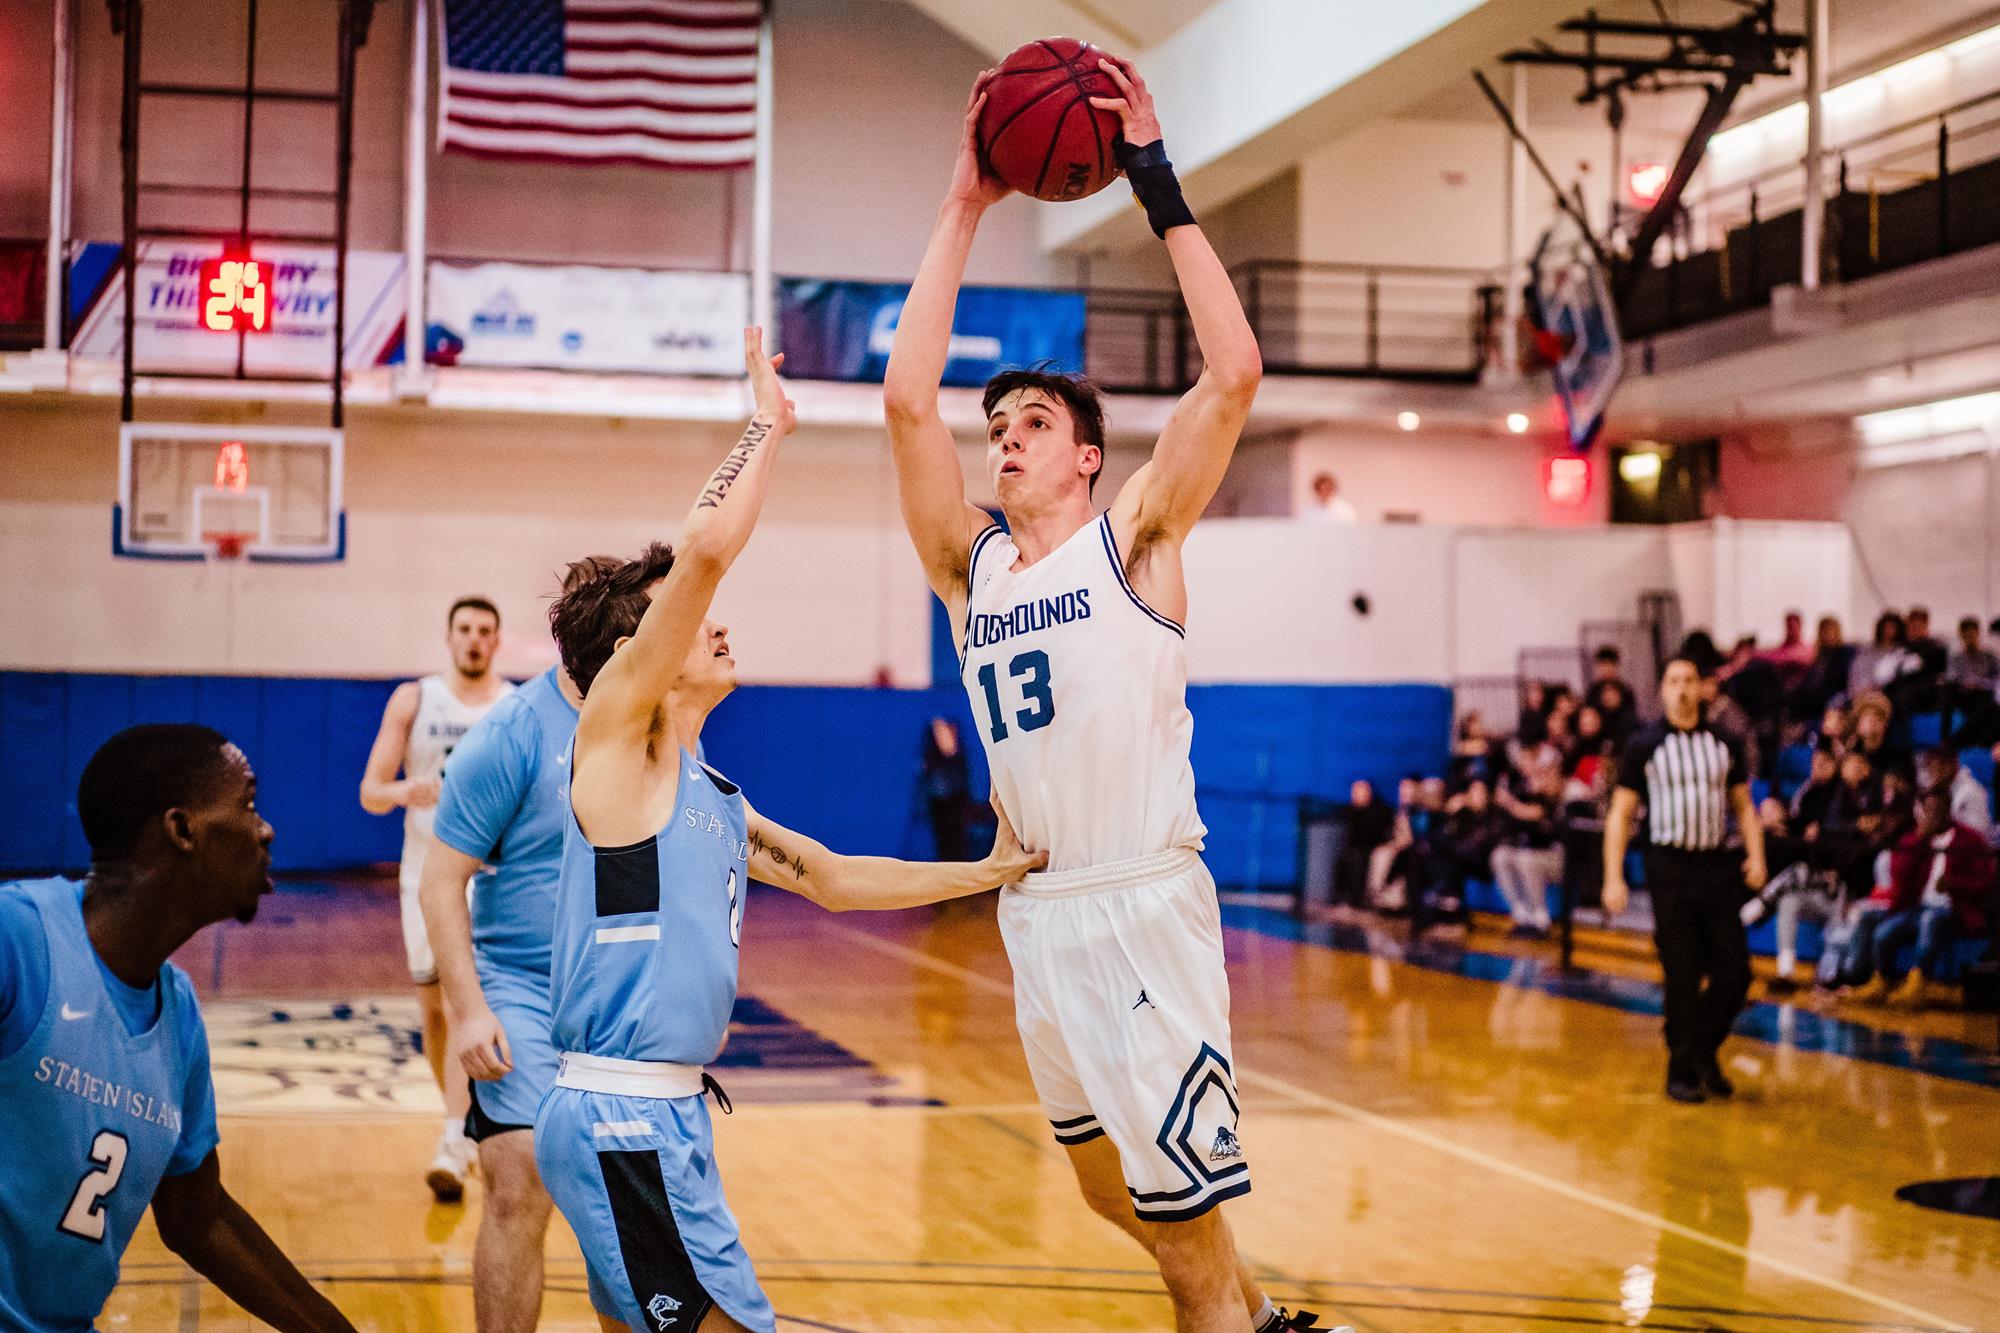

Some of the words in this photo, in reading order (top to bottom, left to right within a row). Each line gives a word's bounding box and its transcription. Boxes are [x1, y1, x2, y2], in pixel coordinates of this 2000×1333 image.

[1062, 161, 1092, 197] NC
[970, 588, 1091, 648] ODHOUNDS
[977, 649, 1056, 744] 13
[34, 1055, 121, 1110] STATEN
[57, 1127, 129, 1244] 2
